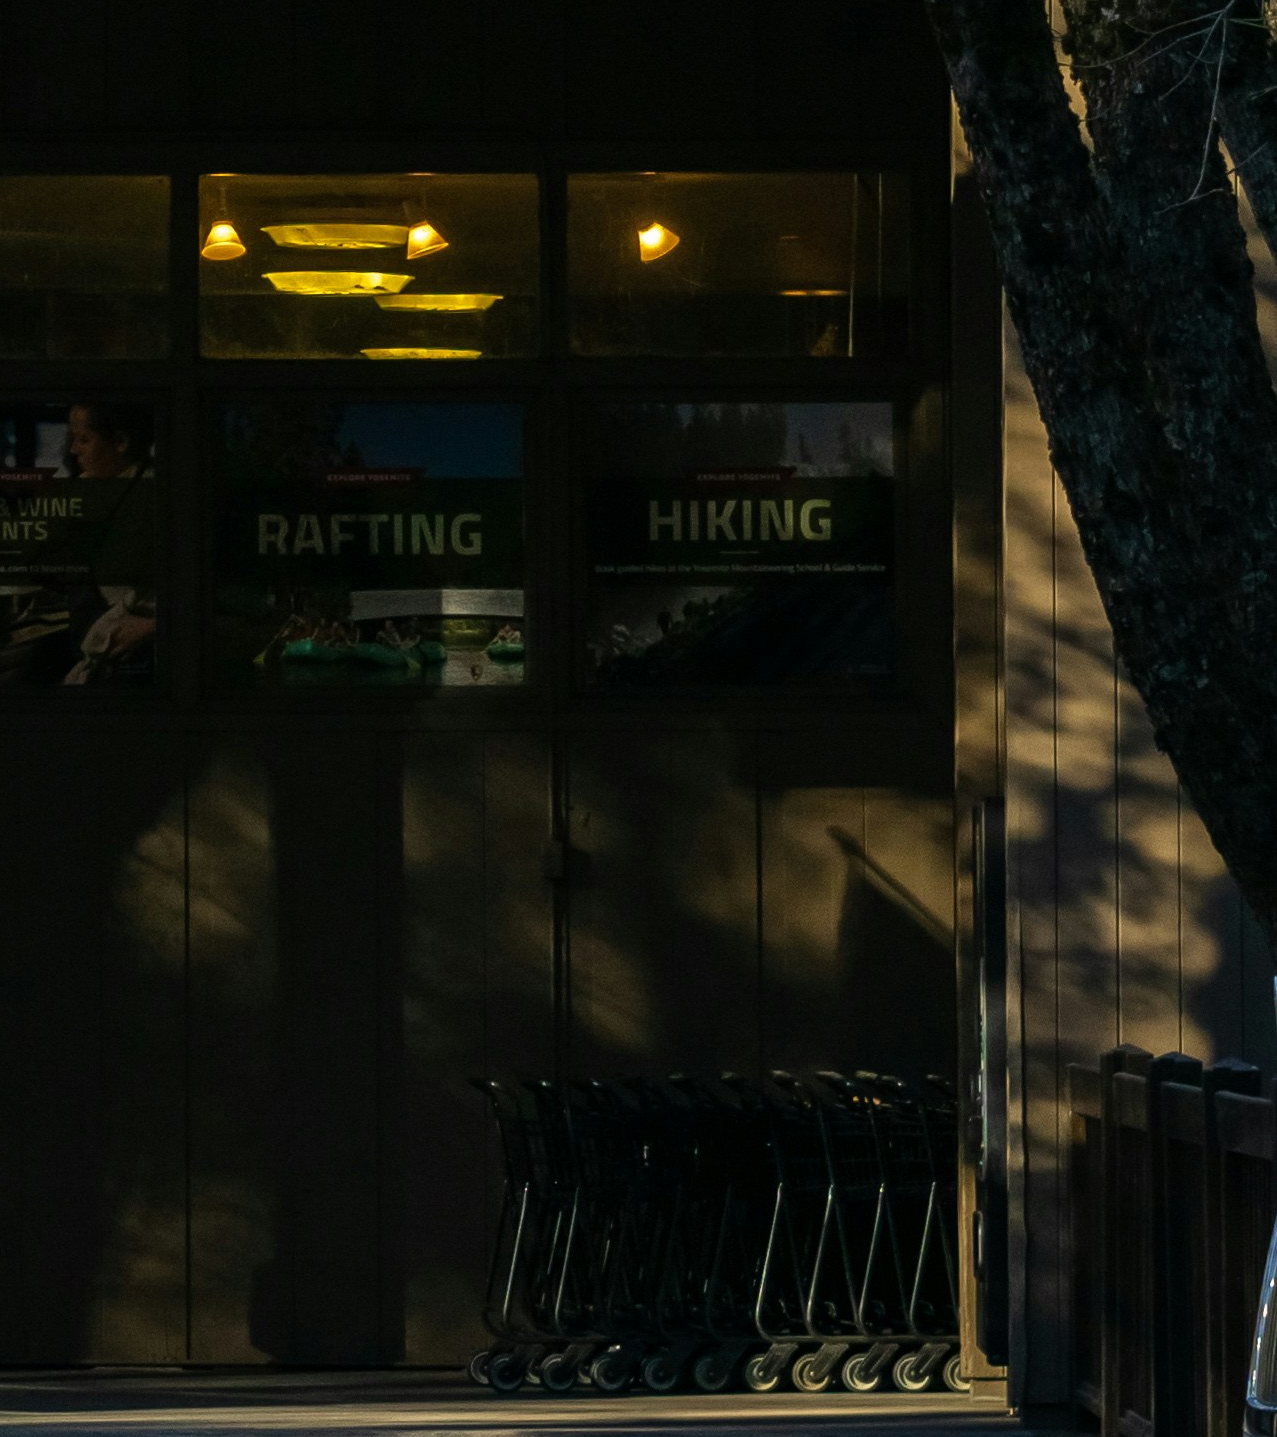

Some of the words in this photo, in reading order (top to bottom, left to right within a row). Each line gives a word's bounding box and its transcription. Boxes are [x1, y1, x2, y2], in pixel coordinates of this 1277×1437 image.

[0, 473, 44, 481] YOSEMITE
[326, 473, 365, 482] EXPLORE
[367, 473, 411, 482] YOSEMITE
[696, 473, 736, 481] EXPLORE
[738, 473, 782, 481] YOSEMITE
[17, 497, 83, 517] WINE
[648, 498, 833, 542] HIKING
[256, 512, 483, 556] RAFTING
